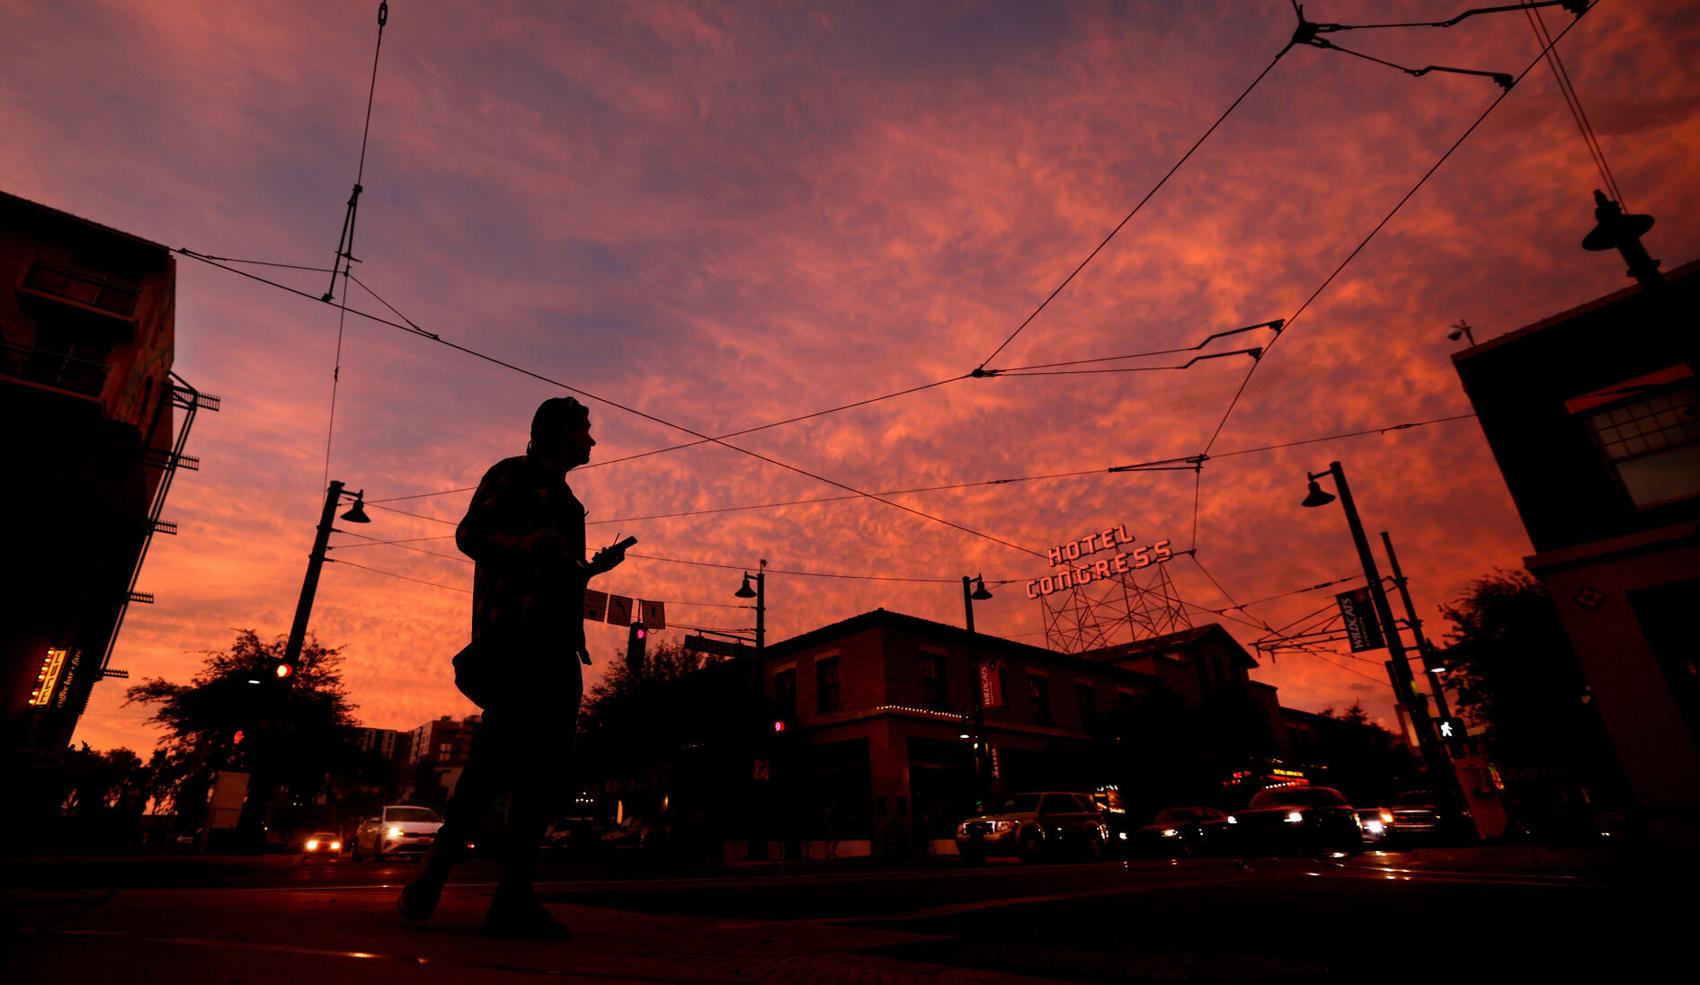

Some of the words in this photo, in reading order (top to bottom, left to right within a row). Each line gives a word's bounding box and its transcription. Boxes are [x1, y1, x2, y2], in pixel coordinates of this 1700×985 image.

[1048, 524, 1134, 567] HOTEL
[1026, 540, 1173, 599] CONGRESS
[1341, 598, 1365, 650] WILDCATS
[64, 670, 74, 685] bar
